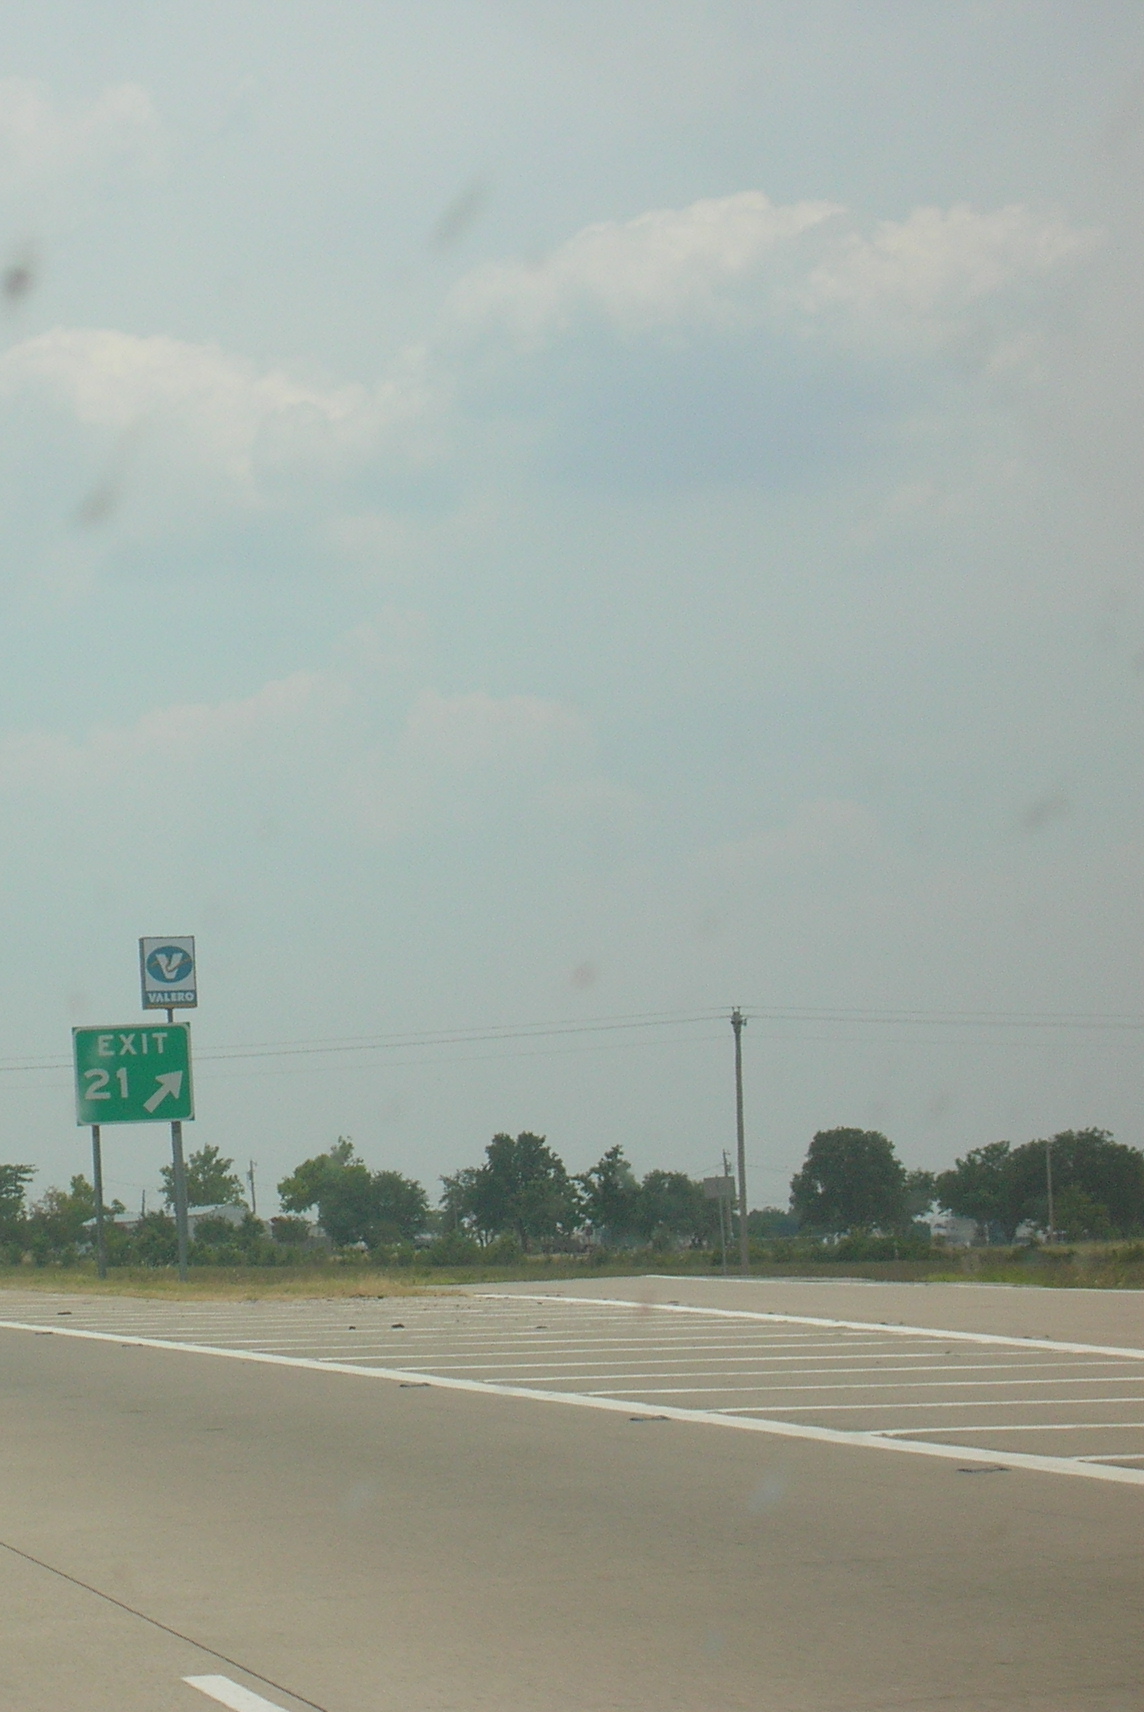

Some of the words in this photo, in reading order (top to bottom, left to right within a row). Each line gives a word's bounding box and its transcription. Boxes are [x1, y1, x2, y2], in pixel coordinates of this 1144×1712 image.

[147, 991, 195, 1003] VALERO
[97, 1032, 168, 1056] EXIT
[84, 1067, 129, 1100] 21
